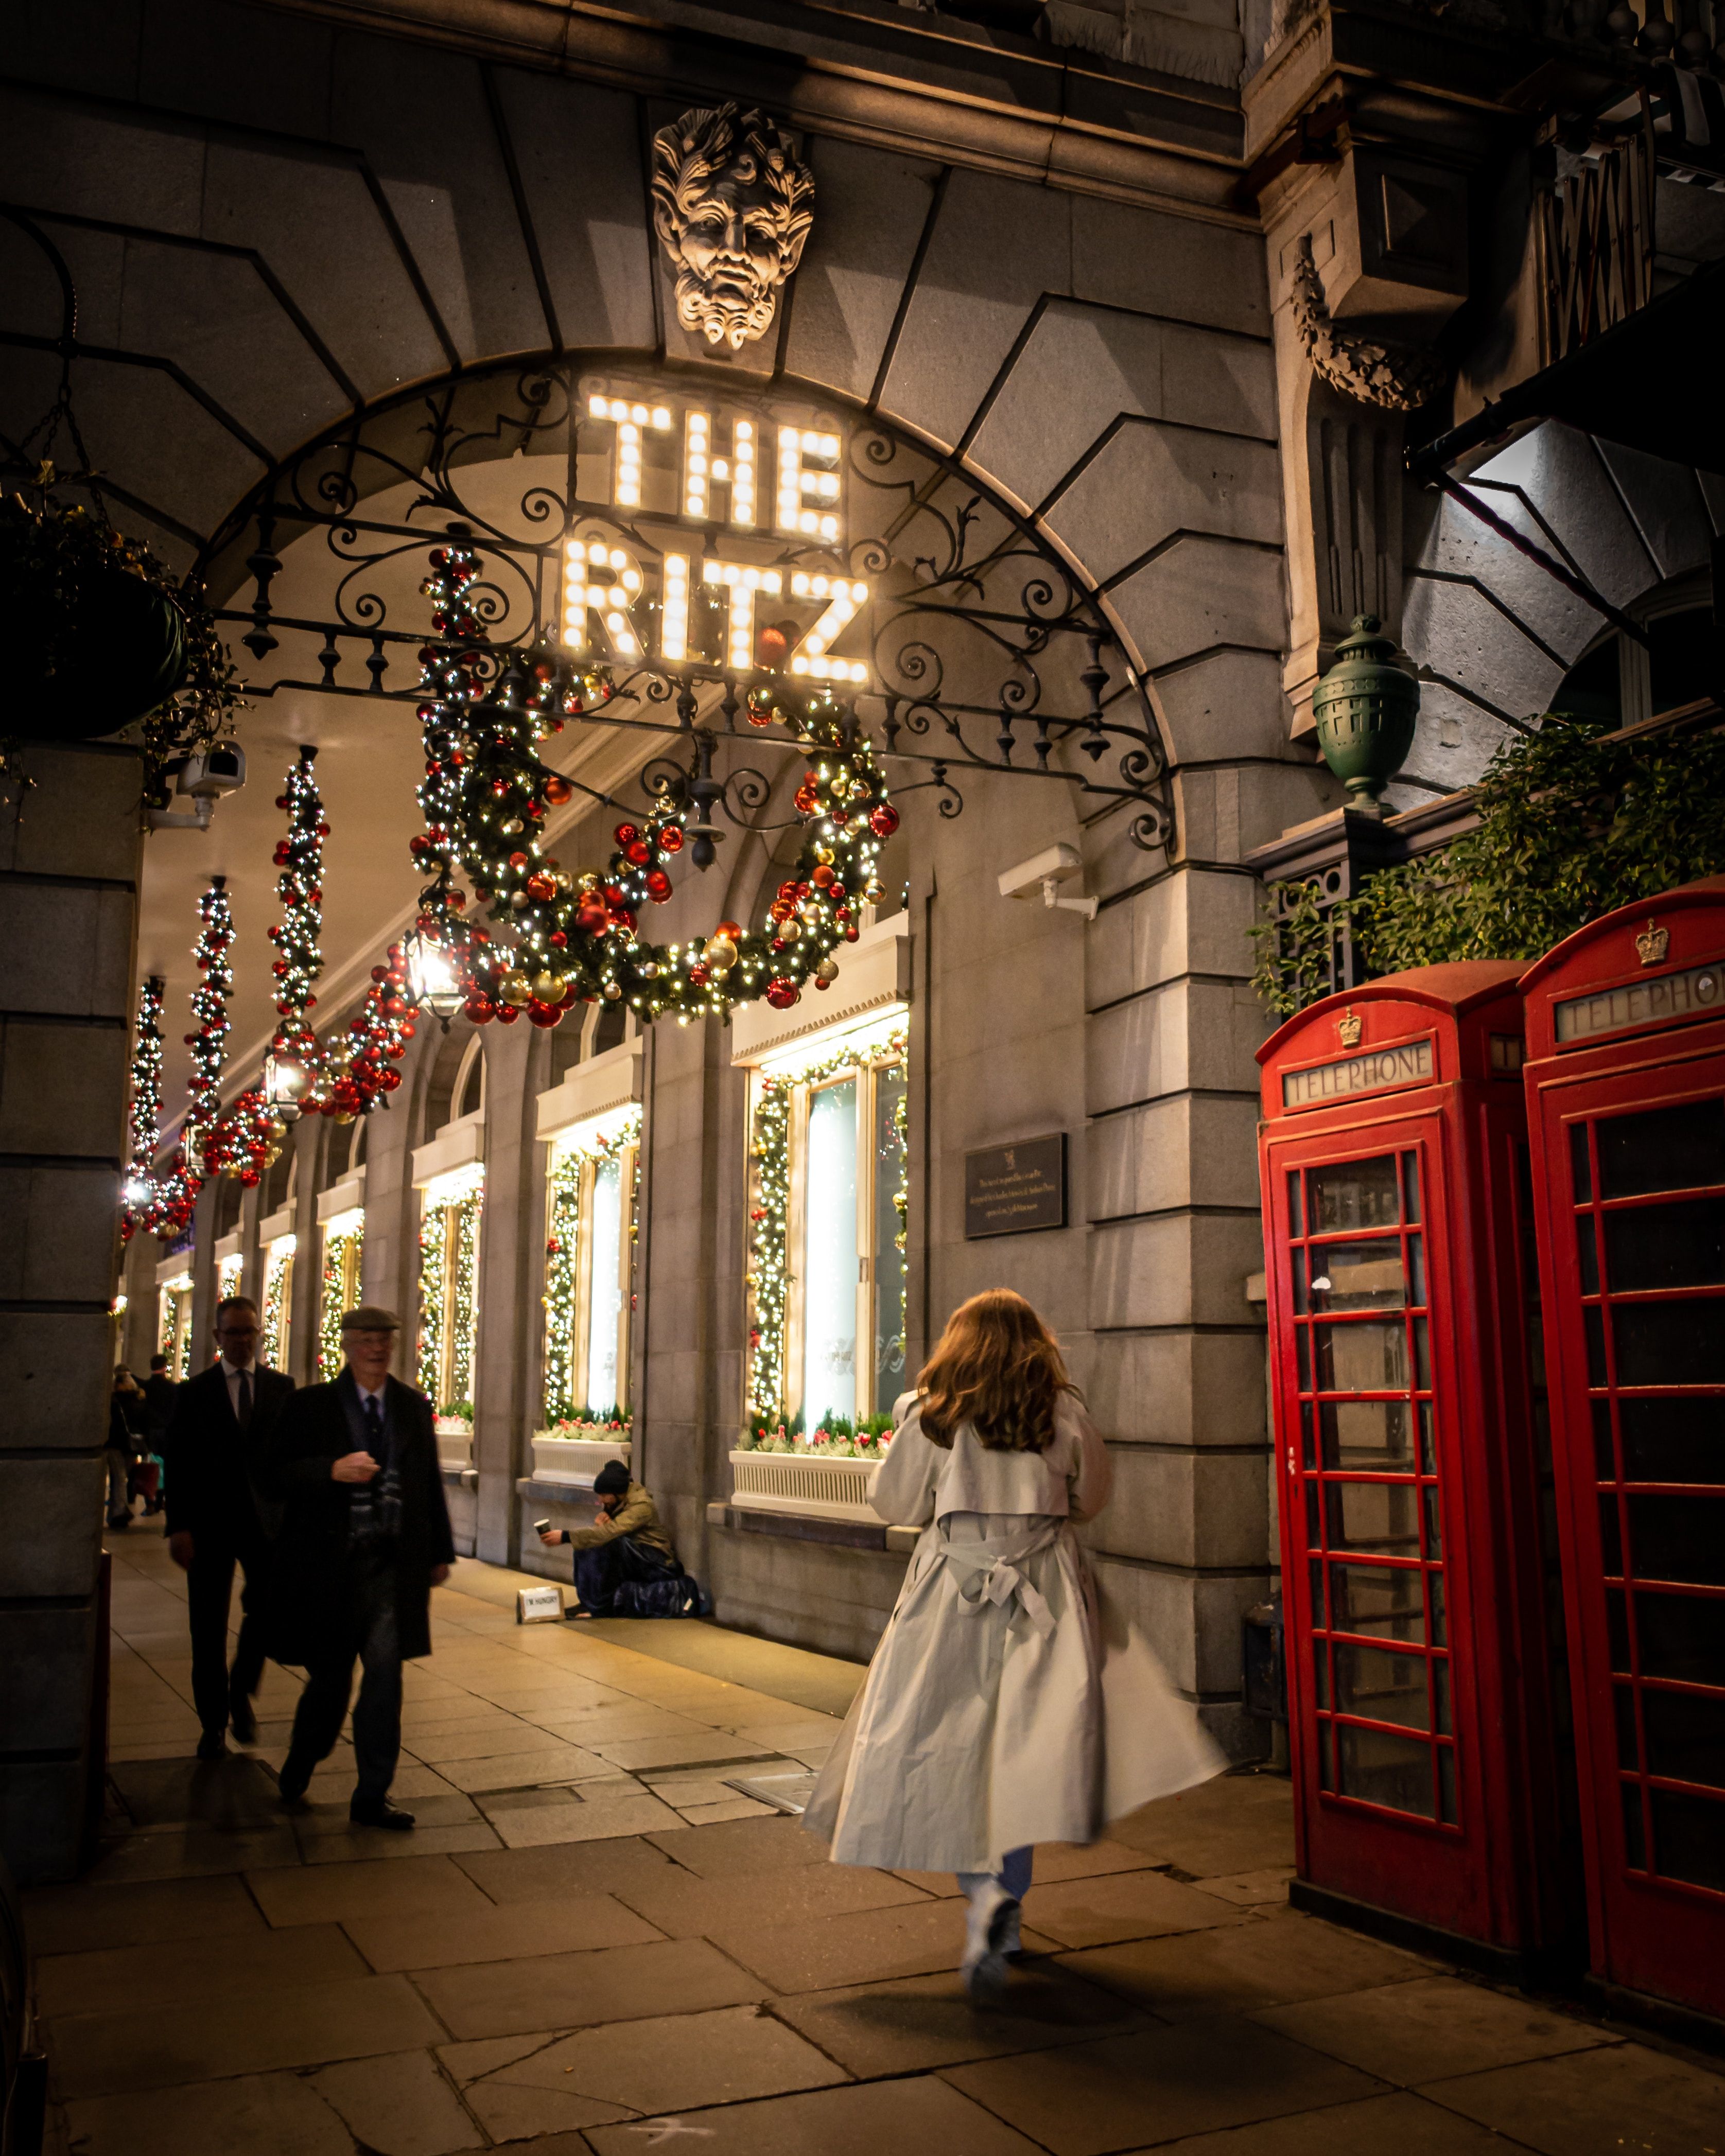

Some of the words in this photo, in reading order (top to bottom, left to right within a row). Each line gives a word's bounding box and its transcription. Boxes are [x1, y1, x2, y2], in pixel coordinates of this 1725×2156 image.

[589, 394, 842, 543] THE
[560, 538, 869, 682] RITZ
[1567, 967, 1725, 1034] TELEPHO
[1291, 1045, 1430, 1101] TELEPHONE
